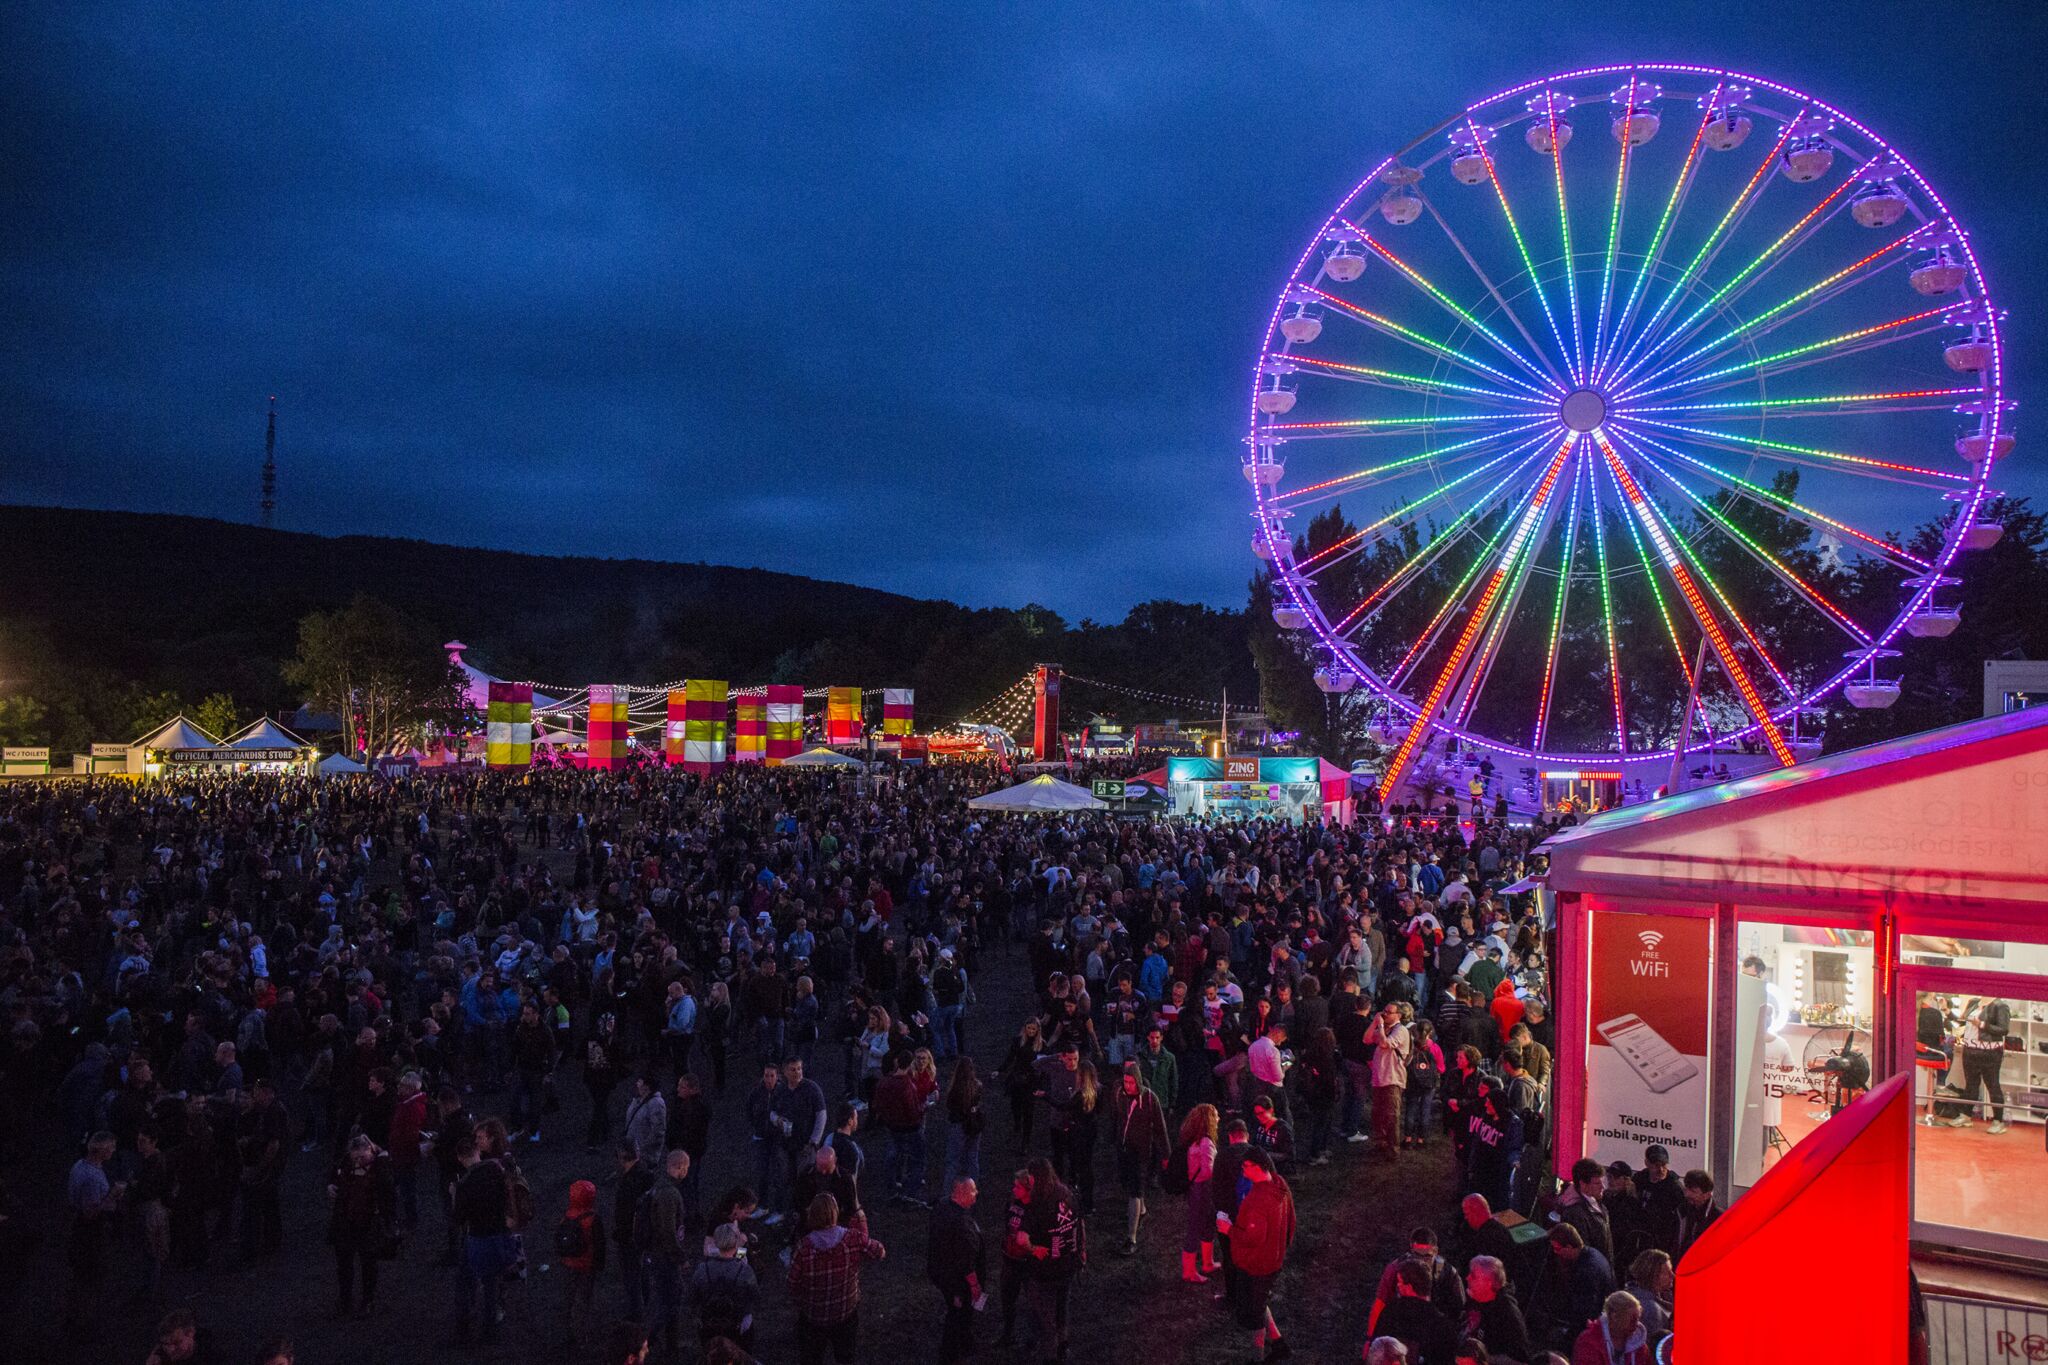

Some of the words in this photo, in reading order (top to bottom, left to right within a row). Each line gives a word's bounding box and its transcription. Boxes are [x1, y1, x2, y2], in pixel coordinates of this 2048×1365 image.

[174, 751, 210, 761] OFFICIAL
[212, 750, 268, 760] MERCHANDISE
[268, 750, 293, 760] STORE
[386, 764, 411, 777] VOLT
[1228, 761, 1255, 774] ZING
[1641, 951, 1660, 959] FREE
[1630, 959, 1669, 978] WiFi
[1619, 1114, 1658, 1129] Töltsd
[1661, 1120, 1672, 1131] le
[1593, 1128, 1629, 1140] mobil
[1632, 1133, 1698, 1149] appunkat!
